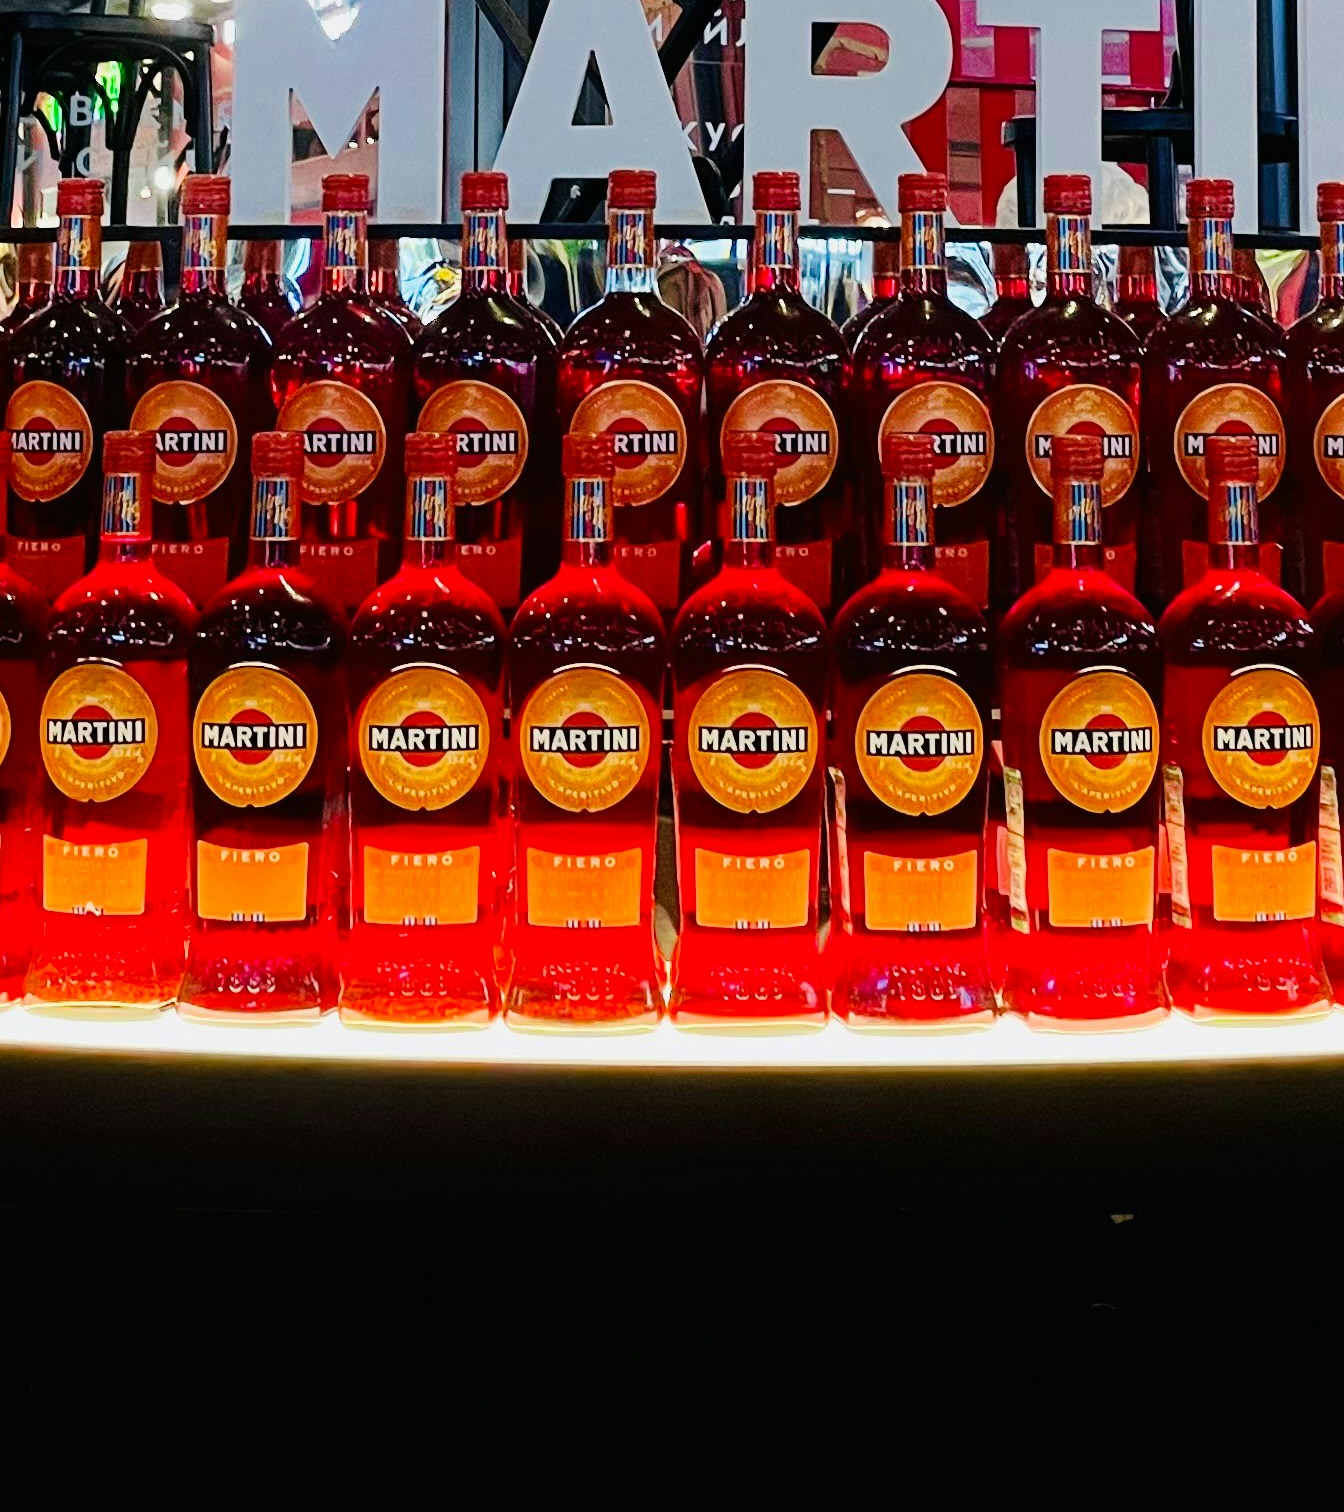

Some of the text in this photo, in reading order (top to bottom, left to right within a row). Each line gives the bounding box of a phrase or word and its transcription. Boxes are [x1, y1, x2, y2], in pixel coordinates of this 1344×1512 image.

[155, 432, 225, 452] ARTINI
[304, 432, 373, 452] ARTINI
[455, 432, 515, 453] RTINI
[614, 433, 675, 453] RTINI
[775, 433, 827, 453] RTINI
[933, 434, 984, 454] RTINI
[461, 544, 496, 555] ERO
[775, 546, 809, 557] ERO
[48, 720, 142, 743] MARTINI
[204, 725, 304, 748] MARTINI
[371, 726, 476, 750] MARTINI
[532, 728, 637, 751] MARTINI
[701, 728, 805, 752] MARTINI
[1054, 729, 1150, 753] MARTINI
[1217, 726, 1312, 750] MARTINI
[869, 731, 972, 755] MARTINI
[63, 845, 120, 858] FIERO
[220, 850, 281, 863] FIERO
[553, 856, 616, 868] FIERO
[894, 860, 955, 872] FIERO
[1077, 857, 1136, 869] FIERO
